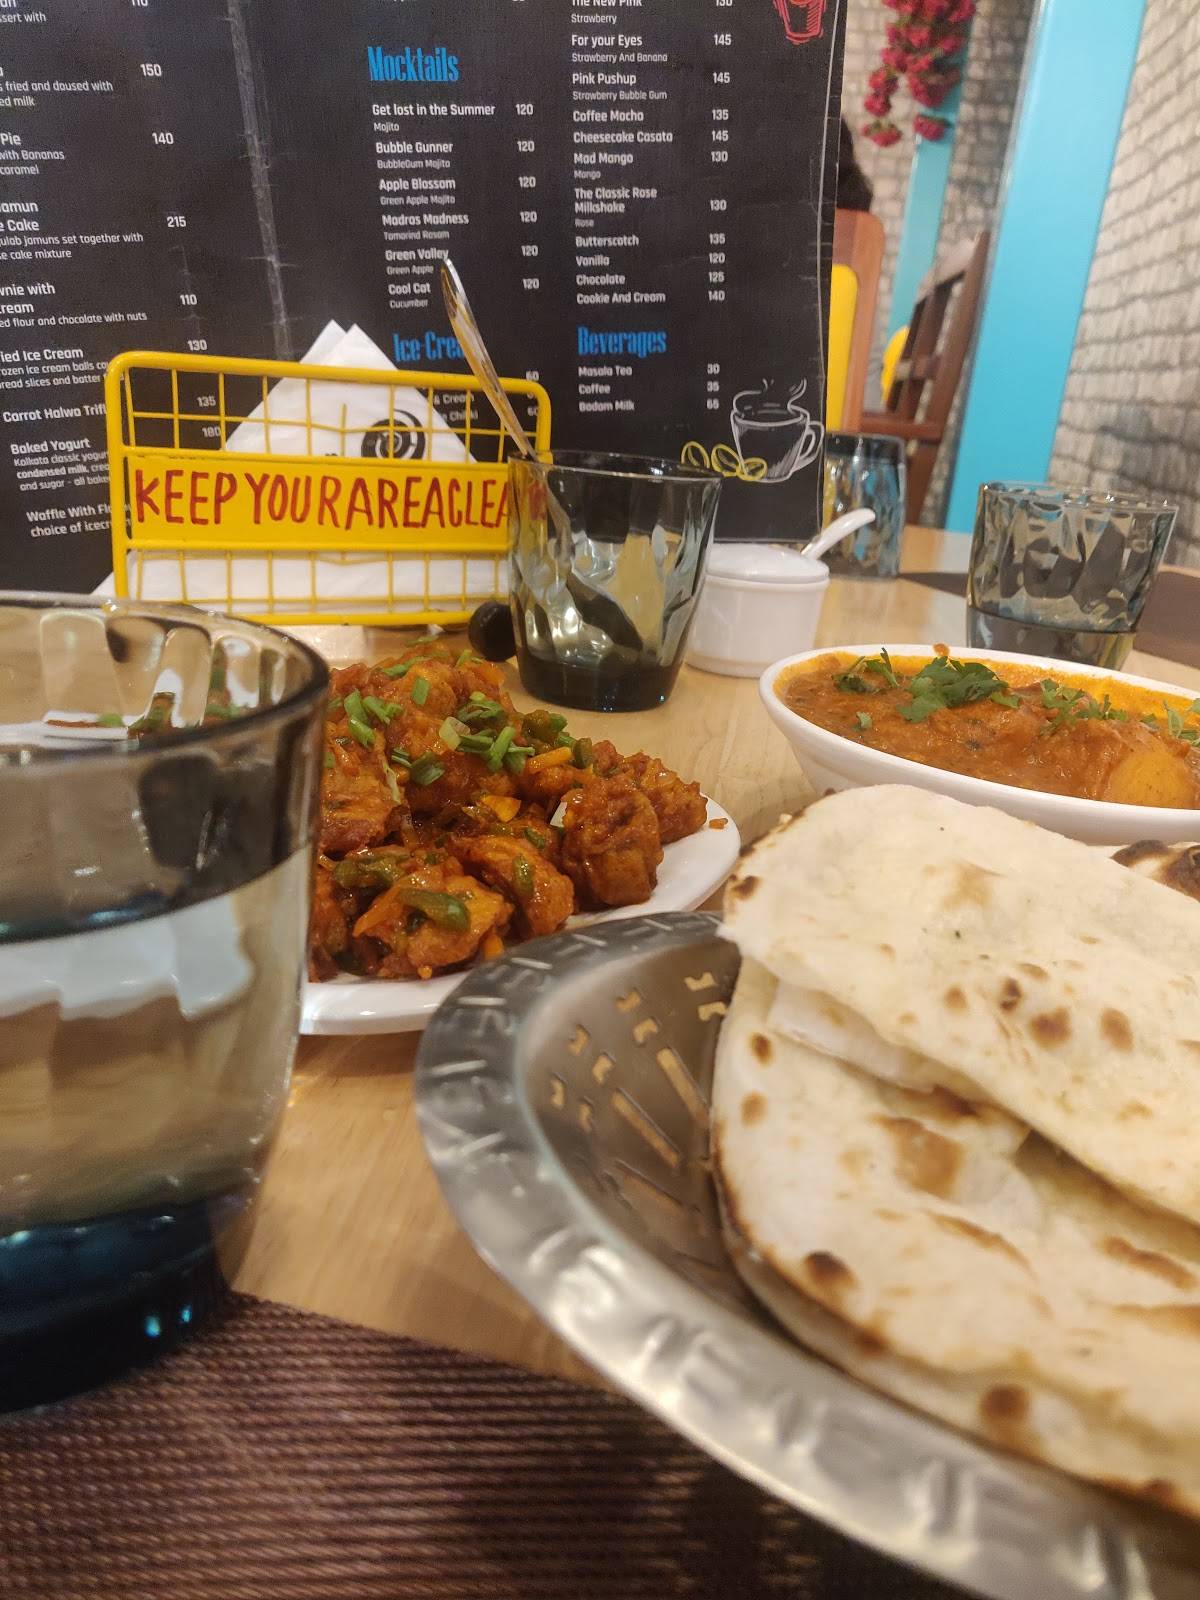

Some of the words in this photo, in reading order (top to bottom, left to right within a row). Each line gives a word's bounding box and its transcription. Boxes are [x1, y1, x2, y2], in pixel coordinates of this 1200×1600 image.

[24, 12, 46, 22] with
[571, 14, 617, 24] Strawberry
[571, 35, 588, 46] For
[591, 37, 616, 48] your
[618, 35, 643, 47] Eyes
[714, 34, 732, 46] 145
[367, 46, 459, 81] Mocktails
[572, 53, 617, 63] Strawberry
[619, 53, 635, 62] And
[636, 53, 668, 62] Banana
[140, 64, 162, 77] 150
[572, 73, 595, 84] Pink
[597, 73, 637, 86] Pushup
[713, 72, 731, 84] 145
[5, 81, 28, 92] fried
[31, 81, 51, 92] and
[53, 81, 89, 92] doused
[91, 80, 114, 91] with
[13, 96, 35, 107] milk
[573, 91, 617, 101] Strawberry
[619, 91, 647, 100] Bubble
[649, 91, 668, 100] Gum
[372, 104, 391, 116] Get
[393, 104, 414, 116] lost
[416, 104, 427, 115] in
[429, 104, 448, 115] the
[450, 104, 496, 116] Summer
[515, 104, 534, 115] 120
[573, 110, 607, 122] Coffee
[610, 110, 644, 121] Mocha
[712, 109, 729, 120] 135
[373, 122, 399, 133] Mojito
[1, 132, 21, 145] Pie
[152, 132, 174, 145] 140
[573, 131, 634, 143] Cheesecake
[637, 131, 673, 142] Casata
[711, 130, 729, 142] 145
[375, 142, 413, 154] Bubble
[415, 142, 453, 153] Gunner
[517, 141, 535, 152] 120
[22, 150, 65, 160] Bananas
[573, 152, 596, 164] Mad
[598, 152, 634, 166] Mango
[711, 151, 728, 162] 130
[0, 164, 40, 175] caramel
[377, 159, 423, 169] BubbleGum
[425, 159, 450, 170] Mojito
[574, 170, 601, 180] Mango
[379, 178, 410, 192] Apple
[411, 178, 456, 190] Blossom
[518, 176, 536, 188] 120
[574, 188, 593, 199] The
[595, 187, 630, 199] Classic
[632, 187, 657, 198] Rose
[380, 196, 405, 206] Green
[406, 196, 429, 206] Apple
[430, 195, 456, 206] Mojito
[574, 202, 626, 213] Milkshake
[710, 200, 727, 211] 130
[7, 218, 40, 232] Cake
[167, 216, 187, 228] 215
[382, 214, 421, 226] Madras
[423, 213, 469, 225] Madness
[520, 211, 538, 223] 120
[24, 235, 60, 247] jamuns
[62, 234, 77, 244] set
[80, 233, 120, 245] together
[122, 232, 144, 242] with
[575, 235, 639, 247] Butterscotch
[709, 233, 726, 245] 135
[10, 249, 33, 260] cake
[35, 248, 72, 259] mixture
[385, 249, 416, 261] Green
[417, 248, 449, 260] Valley
[521, 245, 539, 257] 120
[576, 255, 610, 267] Vanilla
[708, 252, 726, 264] 120
[576, 274, 626, 286] Chocolate
[708, 271, 725, 282] 125
[27, 282, 56, 295] with
[388, 283, 411, 295] Cool
[413, 283, 431, 294] Cat
[523, 278, 540, 290] 120
[179, 294, 197, 306] 110
[576, 293, 610, 304] Cookie
[612, 292, 631, 303] And
[633, 292, 666, 303] Cream
[708, 290, 725, 301] 140
[13, 317, 35, 328] flour
[37, 316, 56, 327] and
[58, 314, 103, 325] chocolate
[104, 312, 125, 323] with
[126, 312, 148, 321] nuts
[187, 339, 207, 351] 130
[393, 333, 420, 362] Ice
[425, 330, 465, 361] Cre
[577, 326, 668, 358] Beverages
[23, 350, 41, 362] Ice
[43, 348, 84, 361] Cream
[26, 365, 40, 375] ice
[42, 363, 71, 374] cream
[73, 361, 95, 372] balls
[578, 366, 613, 377] Masala
[615, 365, 633, 376] Tea
[25, 376, 51, 388] slices
[53, 375, 71, 386] and
[73, 373, 101, 385] batter
[579, 384, 611, 395] Coffee
[197, 396, 216, 407] 135
[579, 401, 613, 412] Badam
[615, 400, 635, 411] Milk
[2, 409, 42, 423] Carrot
[44, 407, 82, 419] Halwa
[83, 403, 107, 416] Trifl
[10, 441, 49, 455] Baked
[50, 438, 91, 452] Yogurt
[13, 456, 49, 468] Kolkata
[51, 454, 80, 464] classic
[82, 451, 109, 462] yogur
[16, 466, 66, 479] condensed
[20, 482, 38, 491] and
[40, 480, 65, 490] sugar
[87, 475, 110, 485] bake
[135, 469, 237, 526] KEEP
[244, 472, 340, 529] YOUR
[26, 508, 66, 522] Waffle
[67, 505, 96, 518] With
[31, 525, 67, 538] choice
[70, 522, 82, 533] of
